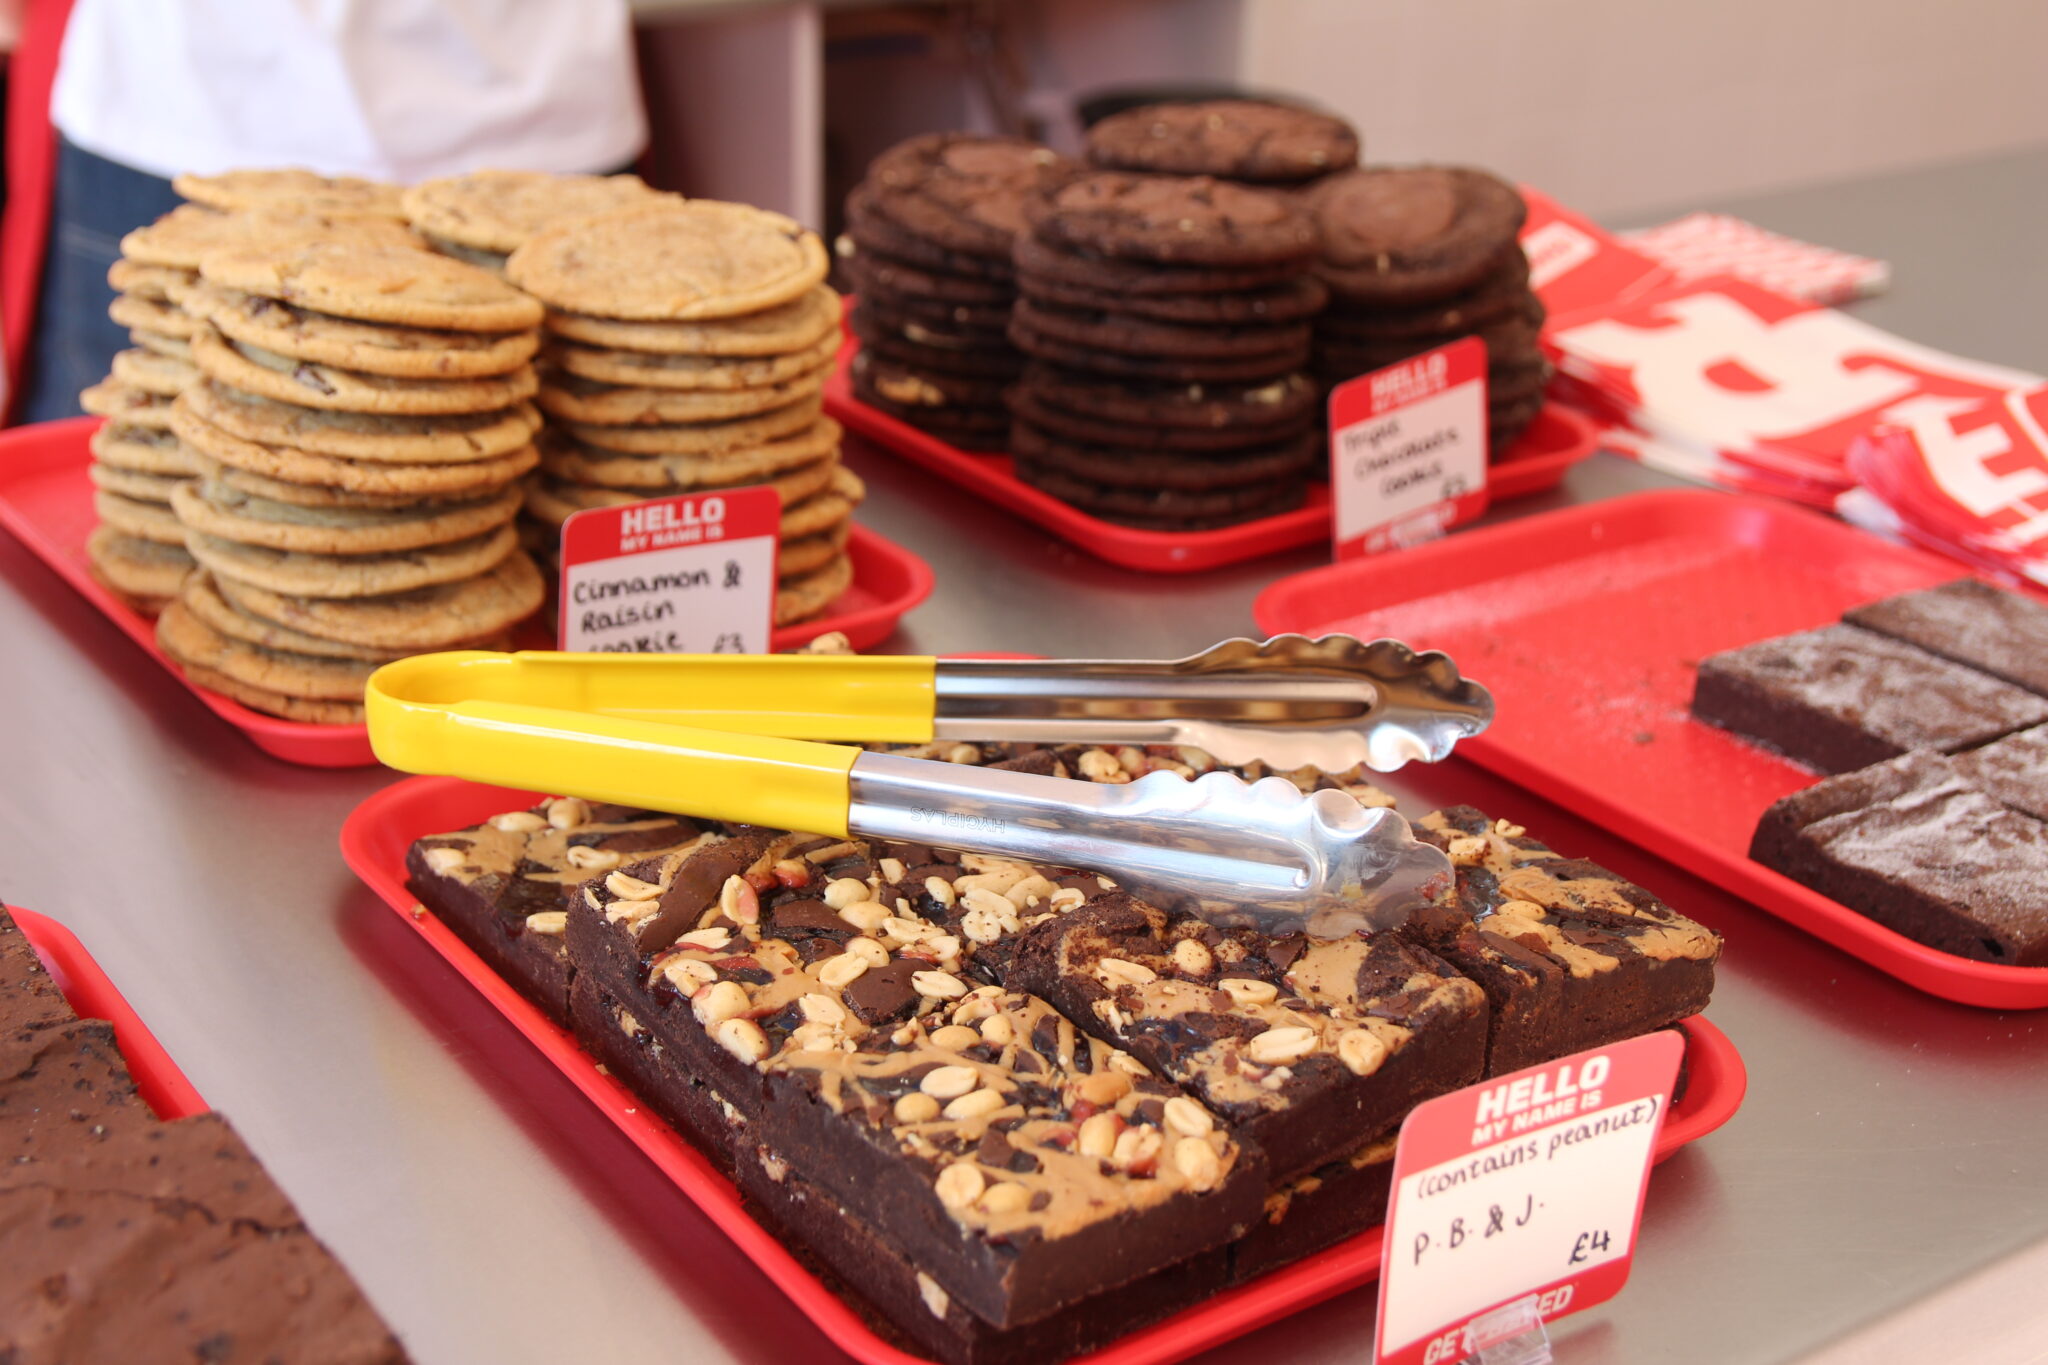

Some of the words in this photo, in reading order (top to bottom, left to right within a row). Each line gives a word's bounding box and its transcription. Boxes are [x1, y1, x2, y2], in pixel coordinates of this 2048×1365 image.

[1370, 353, 1447, 398] HELLO
[620, 497, 726, 536] HELLO
[620, 535, 648, 552] MY
[652, 525, 701, 548] NAME
[706, 523, 724, 539] IS
[573, 569, 709, 604] Cinnamon
[581, 599, 674, 634] Raisin
[910, 807, 1006, 834] HYGIPLAS
[1475, 1055, 1610, 1124] HELLO
[1471, 1122, 1506, 1147] MY
[1511, 1100, 1576, 1134] NAME
[1580, 1089, 1602, 1110] IS
[1417, 1141, 1538, 1200] (contains
[1548, 1097, 1658, 1160] peanut)
[1568, 1230, 1611, 1265] £4
[1422, 1324, 1477, 1365] GET
